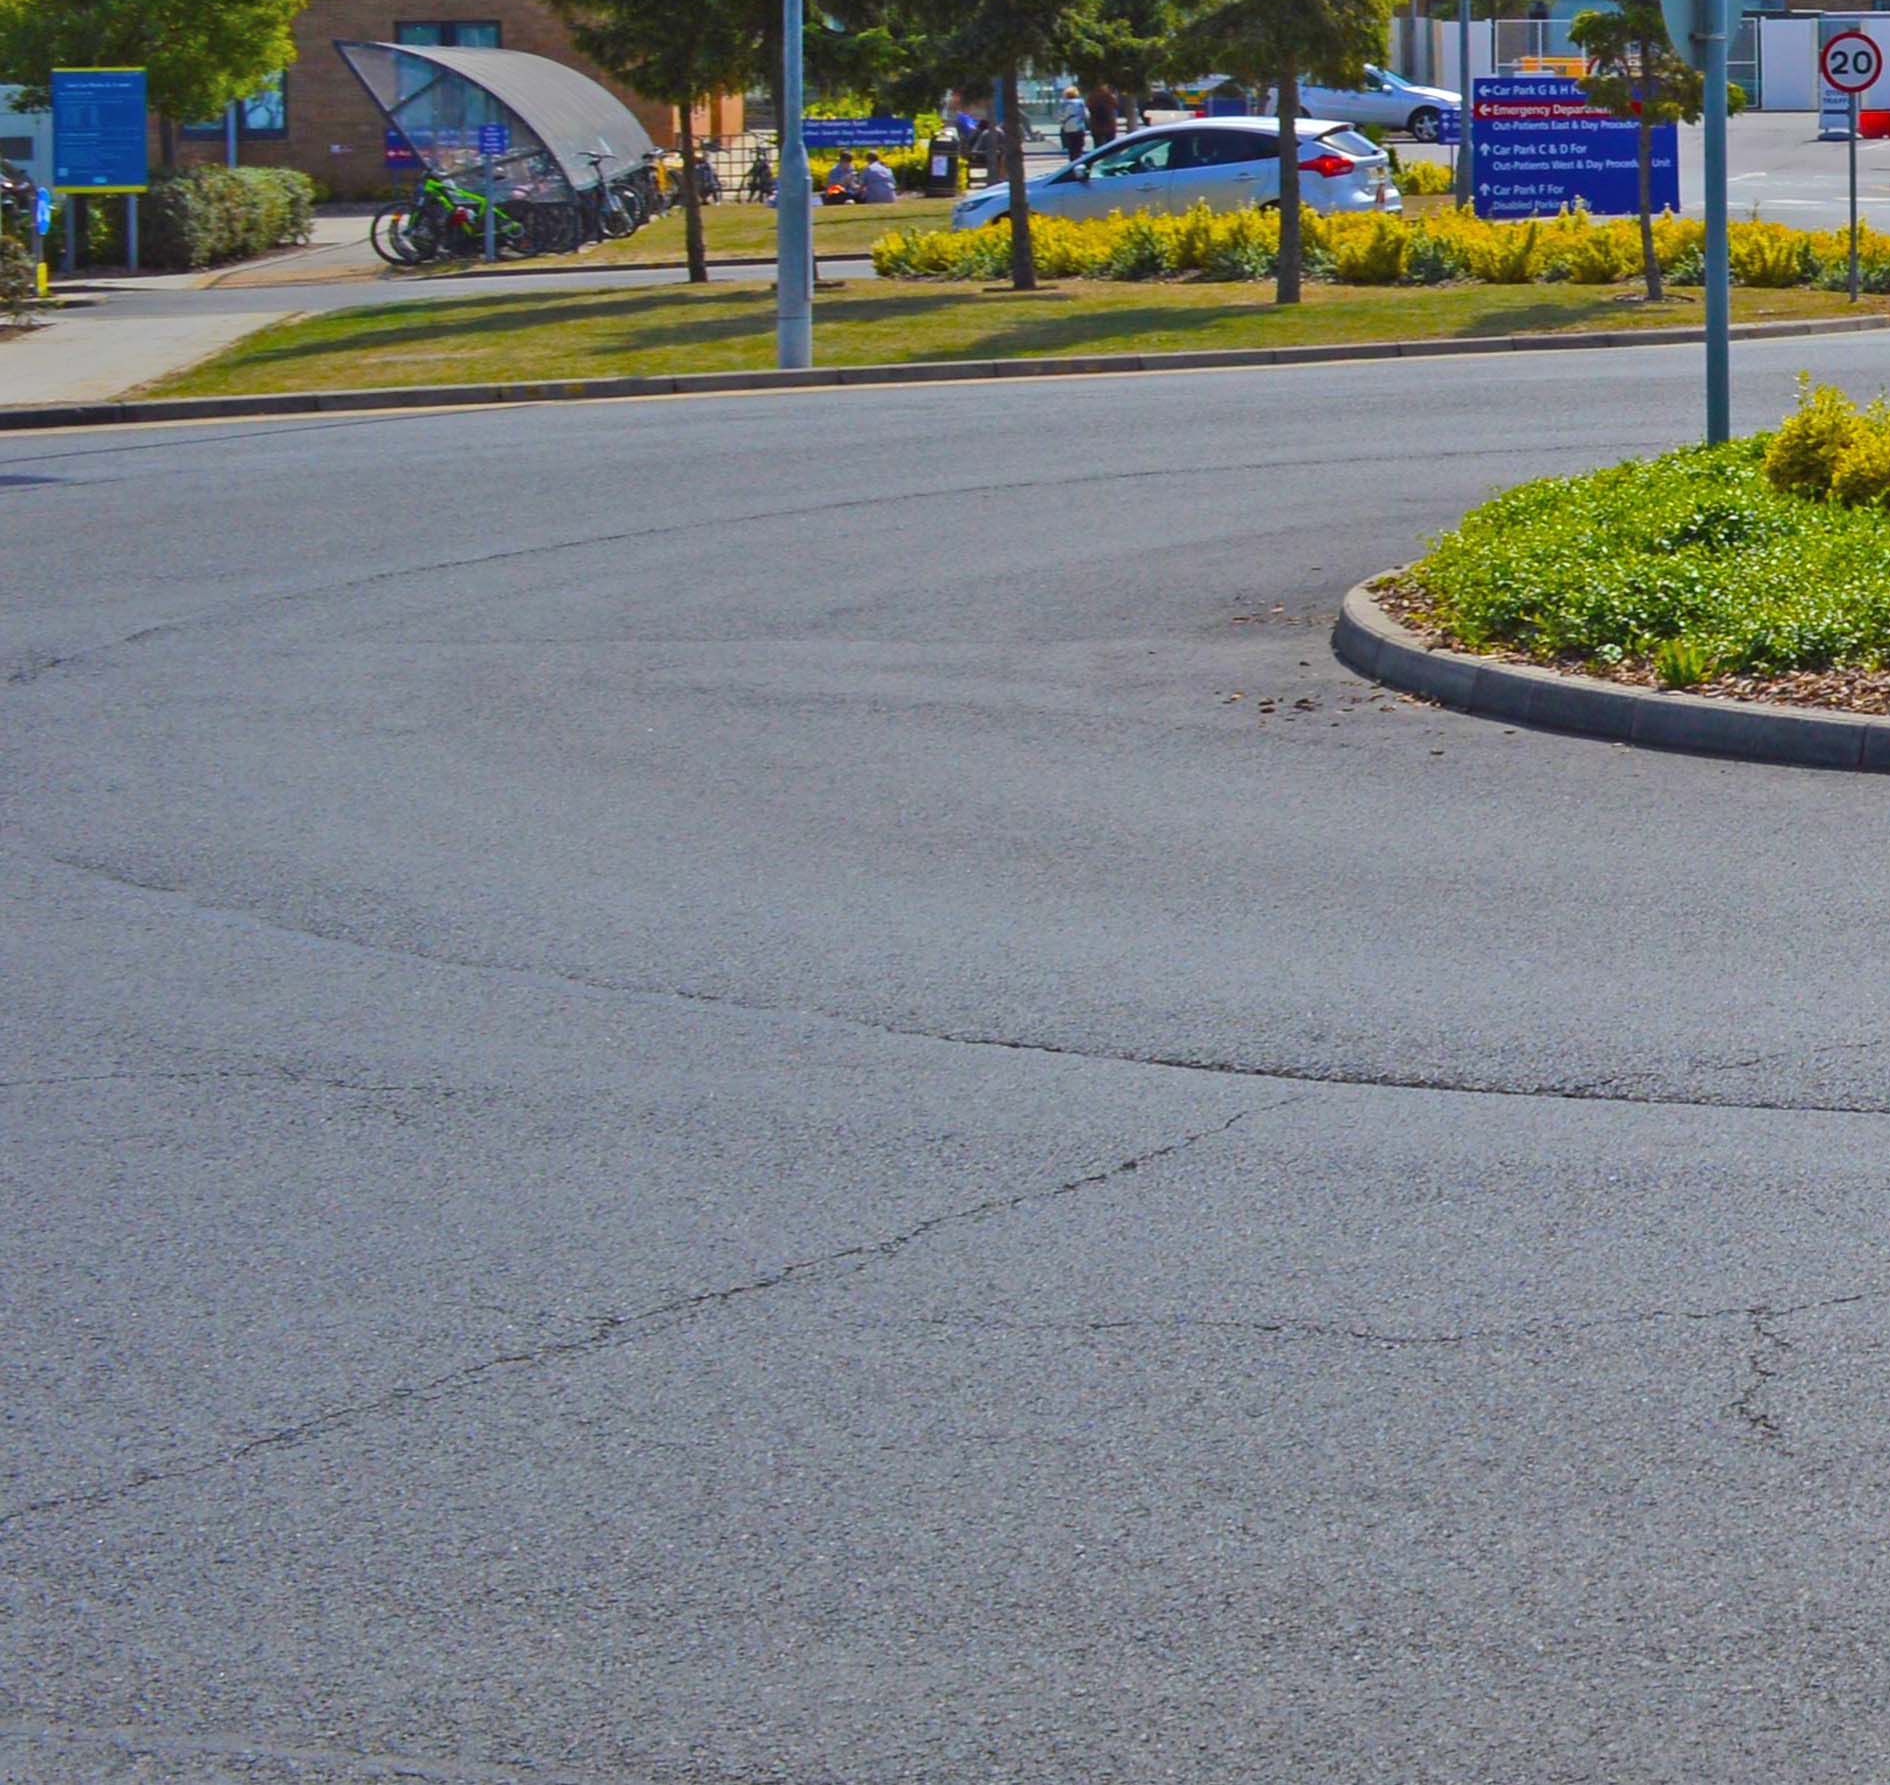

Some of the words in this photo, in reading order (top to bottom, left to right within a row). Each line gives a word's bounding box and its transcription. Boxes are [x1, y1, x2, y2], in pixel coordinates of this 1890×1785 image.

[1830, 50, 1873, 75] 20
[1493, 85, 1511, 96] Car
[1514, 85, 1536, 96] Park
[1538, 85, 1548, 96] G
[1550, 85, 1559, 96] &
[1560, 85, 1569, 96] H
[1493, 104, 1551, 117] Emergency
[1493, 121, 1549, 131] Out-Patients
[1551, 121, 1570, 131] East
[1573, 121, 1580, 130] &
[1581, 121, 1599, 132] Day
[1600, 120, 1642, 130] Procedur
[1493, 144, 1511, 155] Car
[1514, 144, 1536, 155] Park
[1538, 144, 1548, 154] C
[1550, 144, 1559, 154] &
[1560, 144, 1569, 154] D
[1571, 143, 1588, 154] For
[1493, 161, 1550, 172] Out-Patients
[1552, 160, 1574, 170] West
[1576, 160, 1583, 170] &
[1585, 160, 1604, 172] Day
[1652, 158, 1671, 168] Unit
[1493, 185, 1511, 196] Car
[1514, 185, 1536, 195] Park
[1548, 184, 1565, 195] For
[1492, 200, 1532, 211] Disabled
[1534, 200, 1563, 211] Parkin
